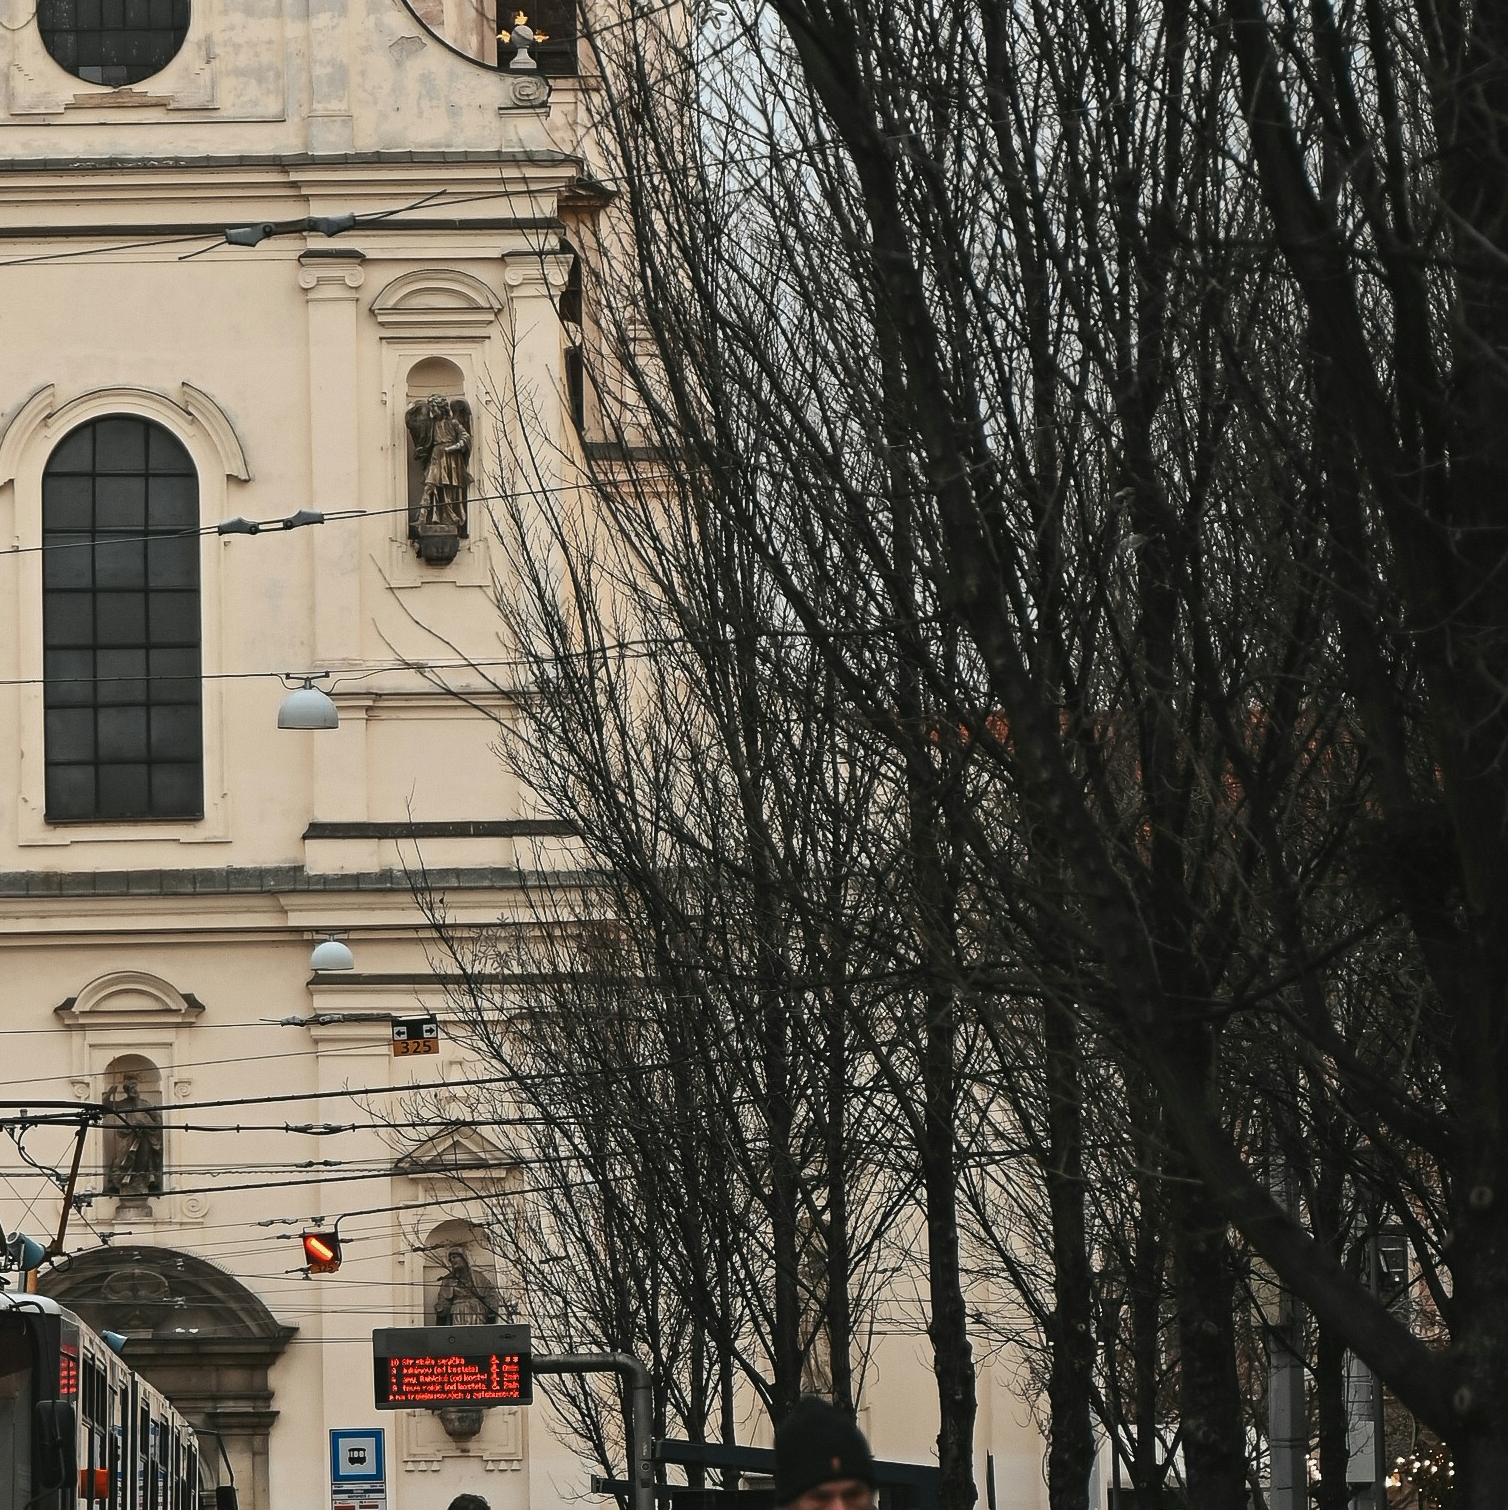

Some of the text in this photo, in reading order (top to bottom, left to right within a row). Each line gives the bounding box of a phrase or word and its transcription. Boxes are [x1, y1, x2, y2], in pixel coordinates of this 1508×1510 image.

[401, 1040, 432, 1054] 325
[316, 1263, 334, 1273] 325
[390, 1358, 400, 1367] 10
